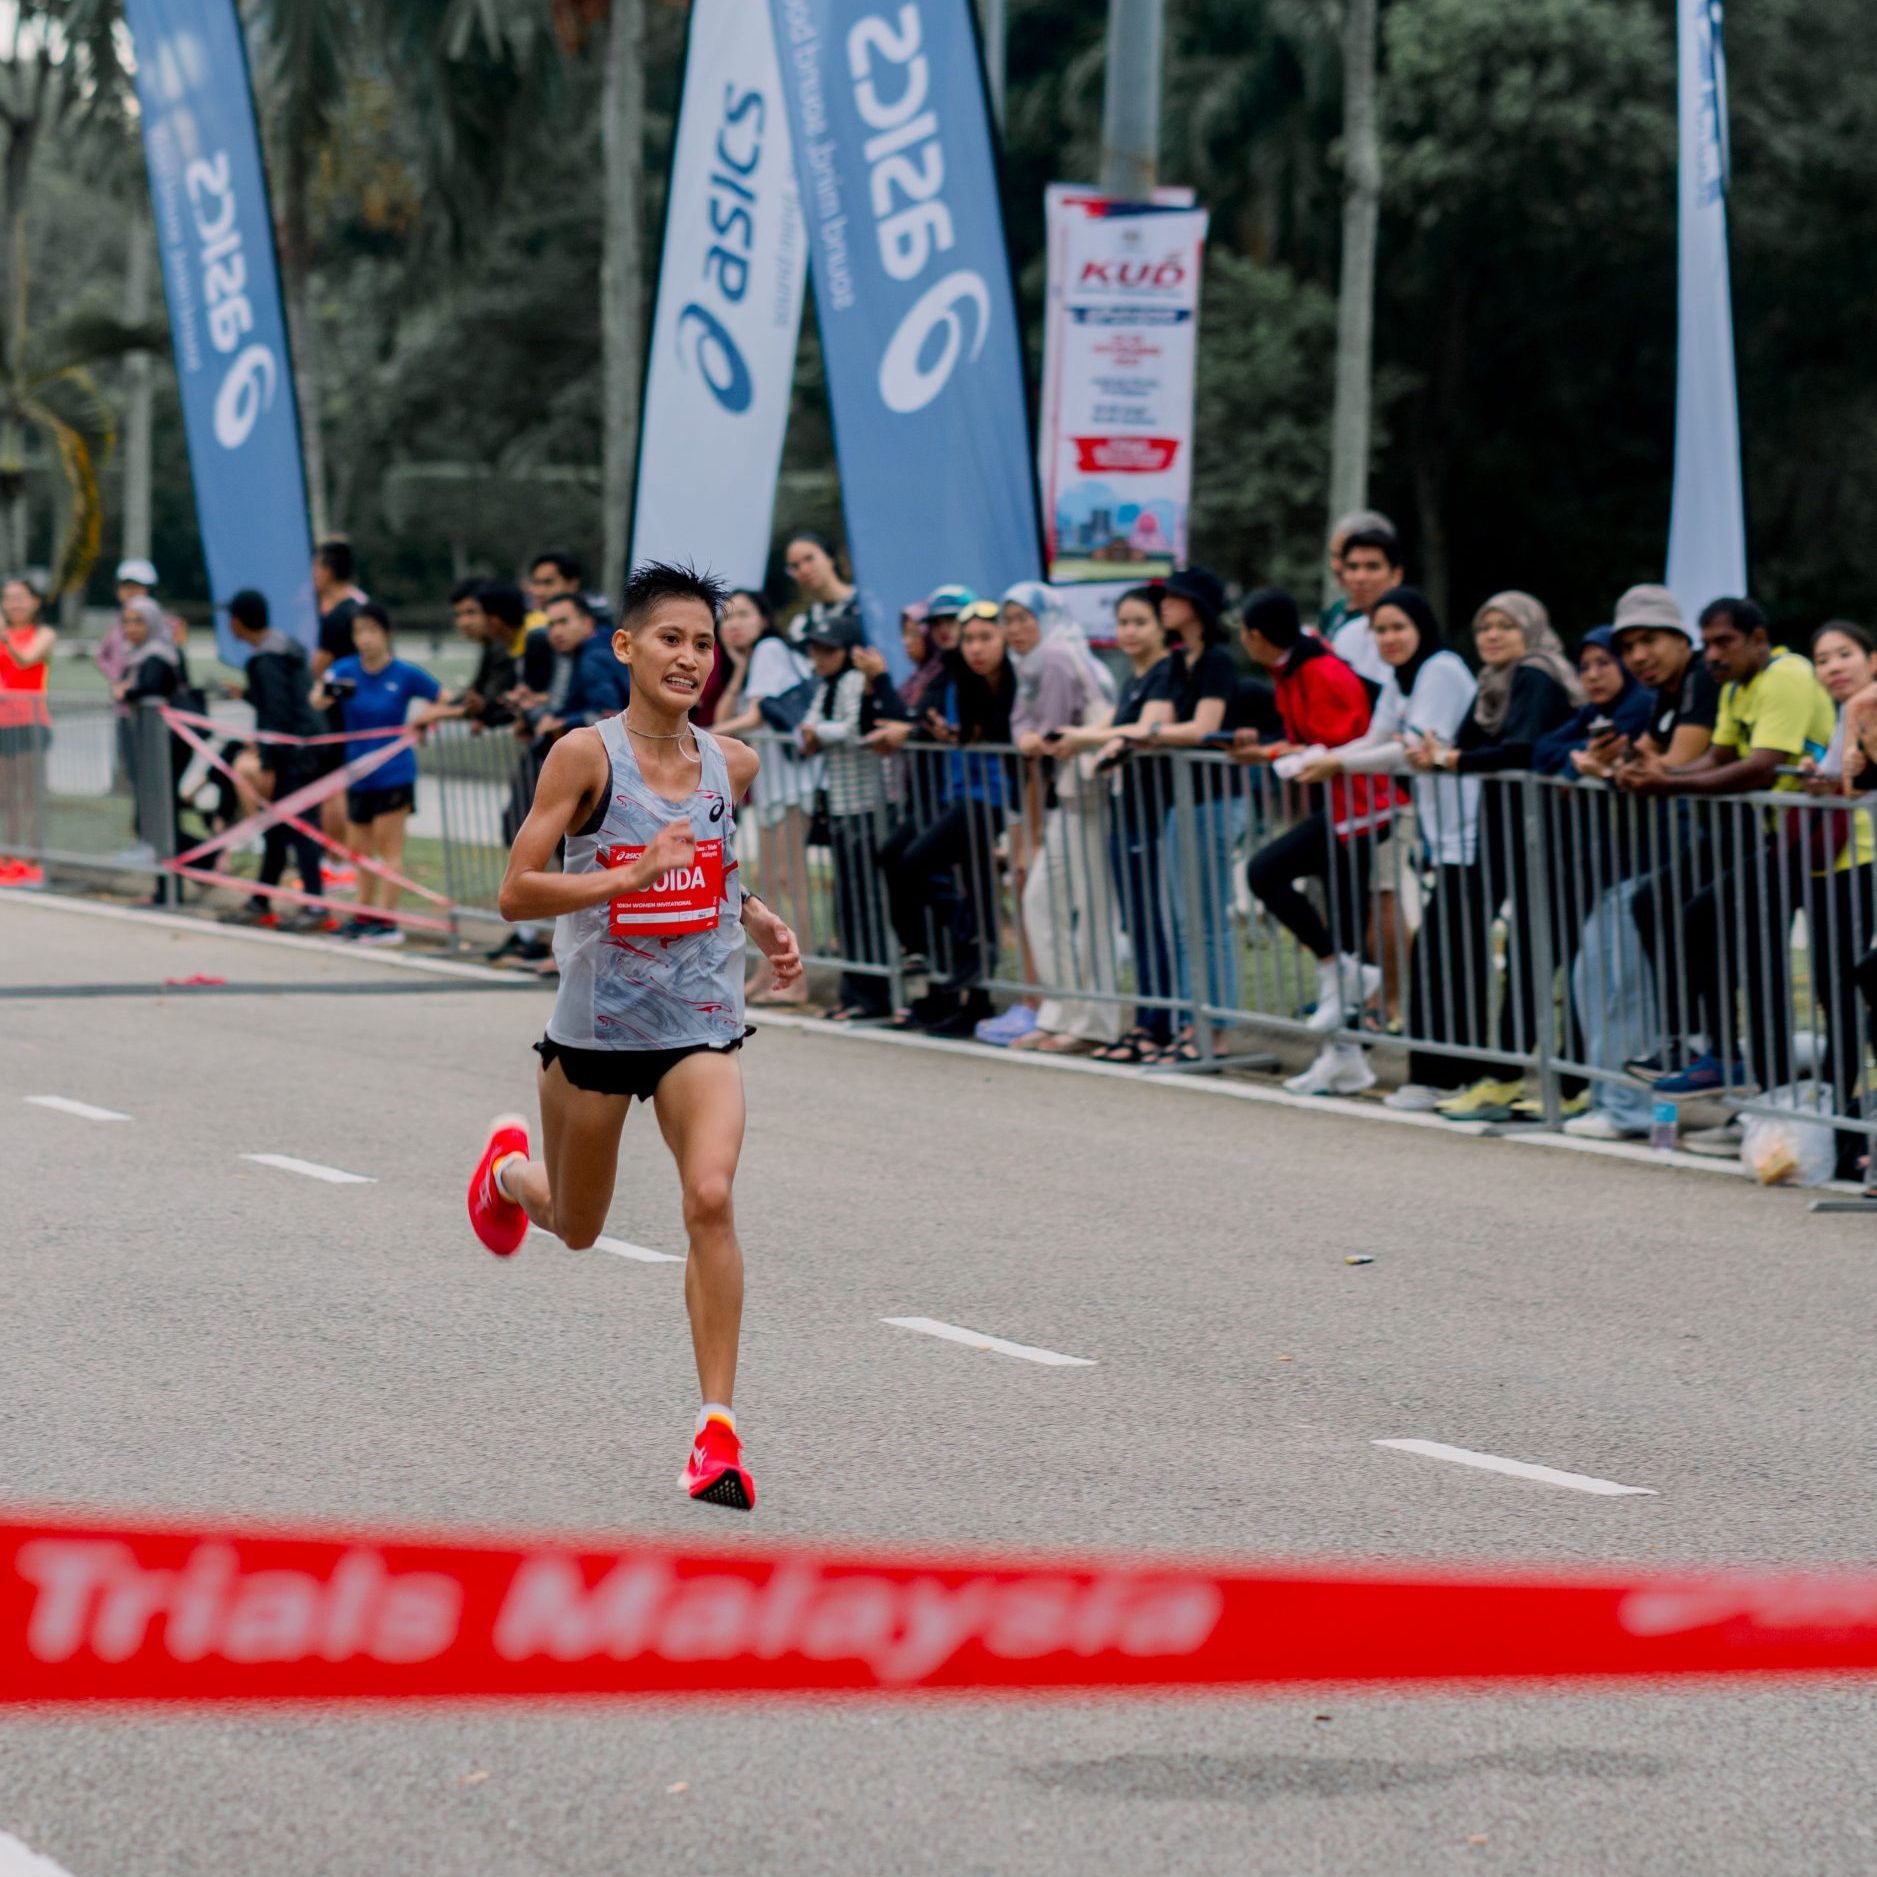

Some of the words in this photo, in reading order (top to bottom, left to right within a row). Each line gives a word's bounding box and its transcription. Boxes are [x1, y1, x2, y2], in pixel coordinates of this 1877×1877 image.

[702, 80, 766, 303] asics
[638, 866, 706, 892] OIDA
[15, 1535, 464, 1663] Trials
[492, 1550, 1224, 1686] Malaysia
